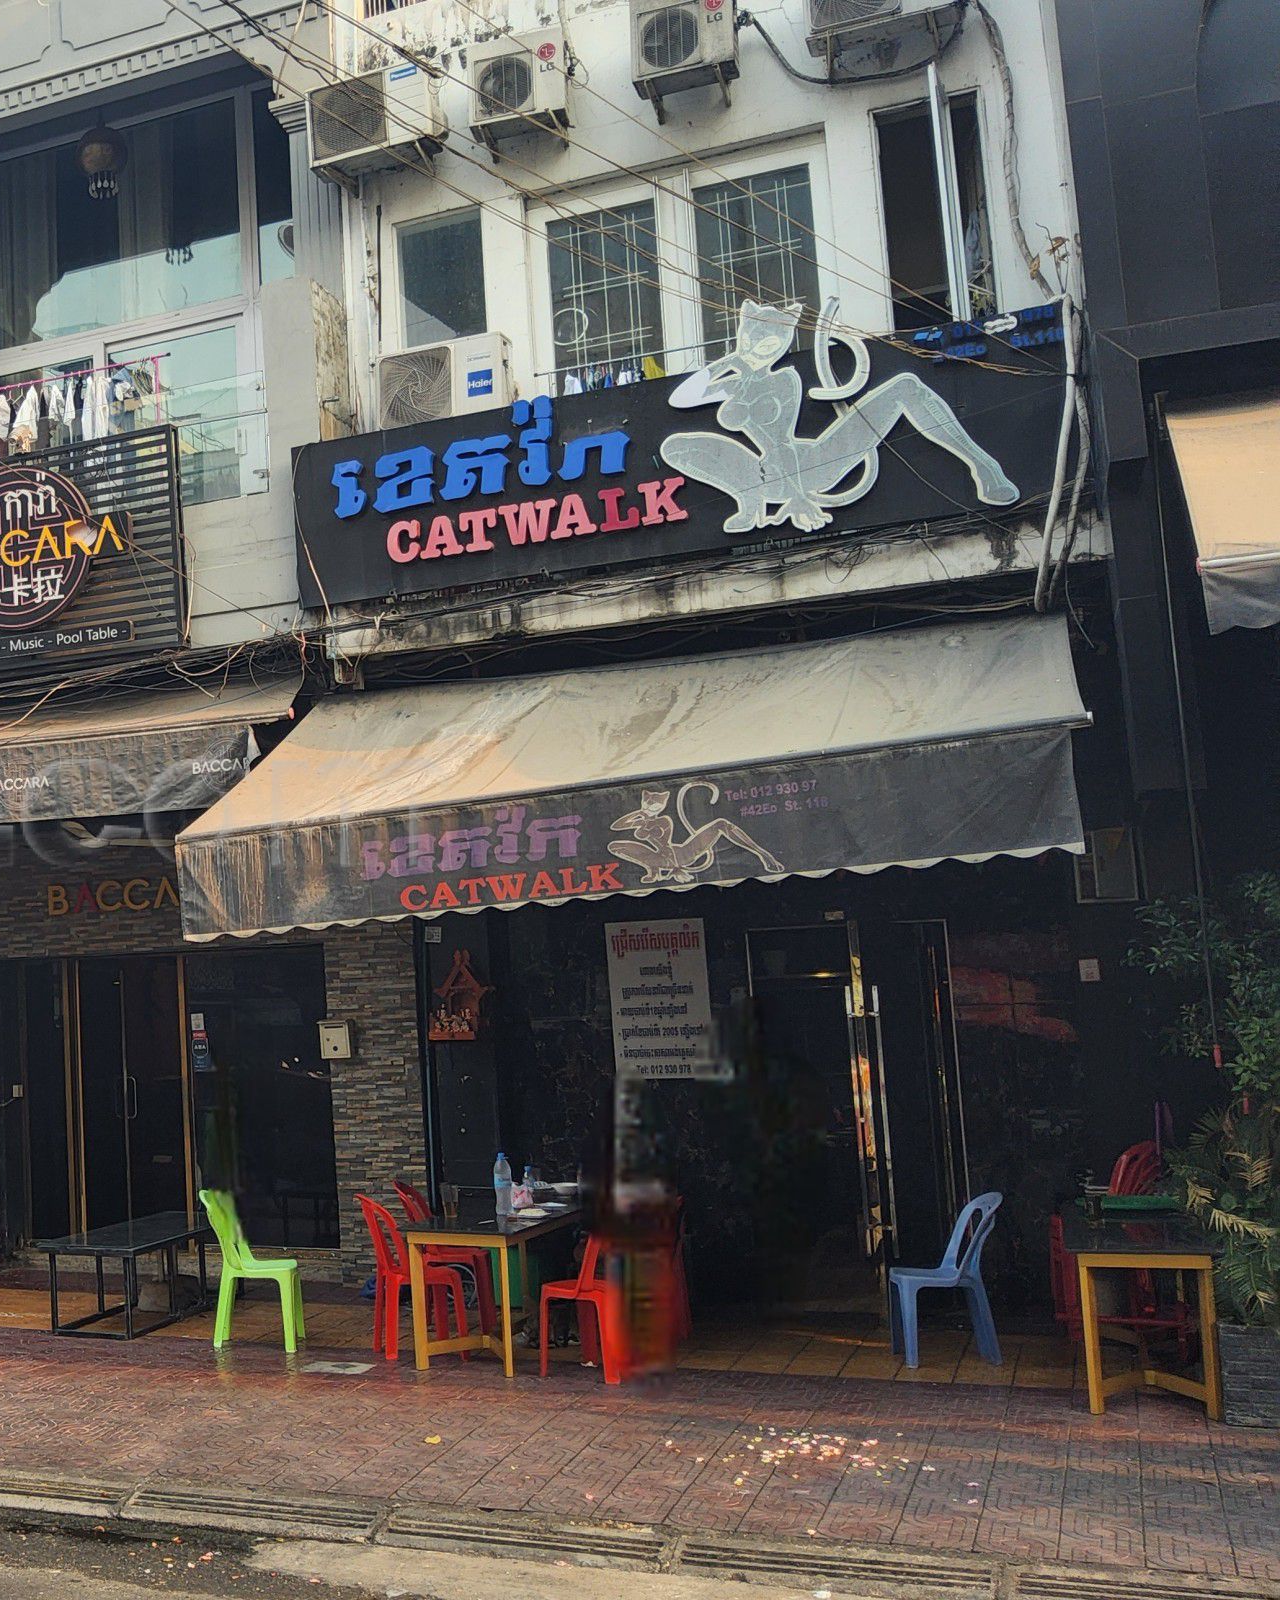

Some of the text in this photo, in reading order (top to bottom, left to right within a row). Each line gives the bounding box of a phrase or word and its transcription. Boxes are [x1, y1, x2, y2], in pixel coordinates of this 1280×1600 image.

[706, 12, 723, 24] LG
[539, 62, 556, 73] LG
[468, 378, 493, 389] Haier
[386, 476, 689, 563] CATWALK
[9, 636, 44, 652] Music
[56, 630, 83, 646] Pool
[86, 626, 118, 642] Table
[724, 789, 748, 801] Tel:
[750, 786, 773, 798] 012
[776, 782, 799, 795] 930
[785, 800, 802, 812] St.
[400, 862, 623, 912] CATWALK
[636, 1065, 649, 1074] Tel:
[650, 1064, 664, 1074] 012
[665, 1064, 678, 1074] 930
